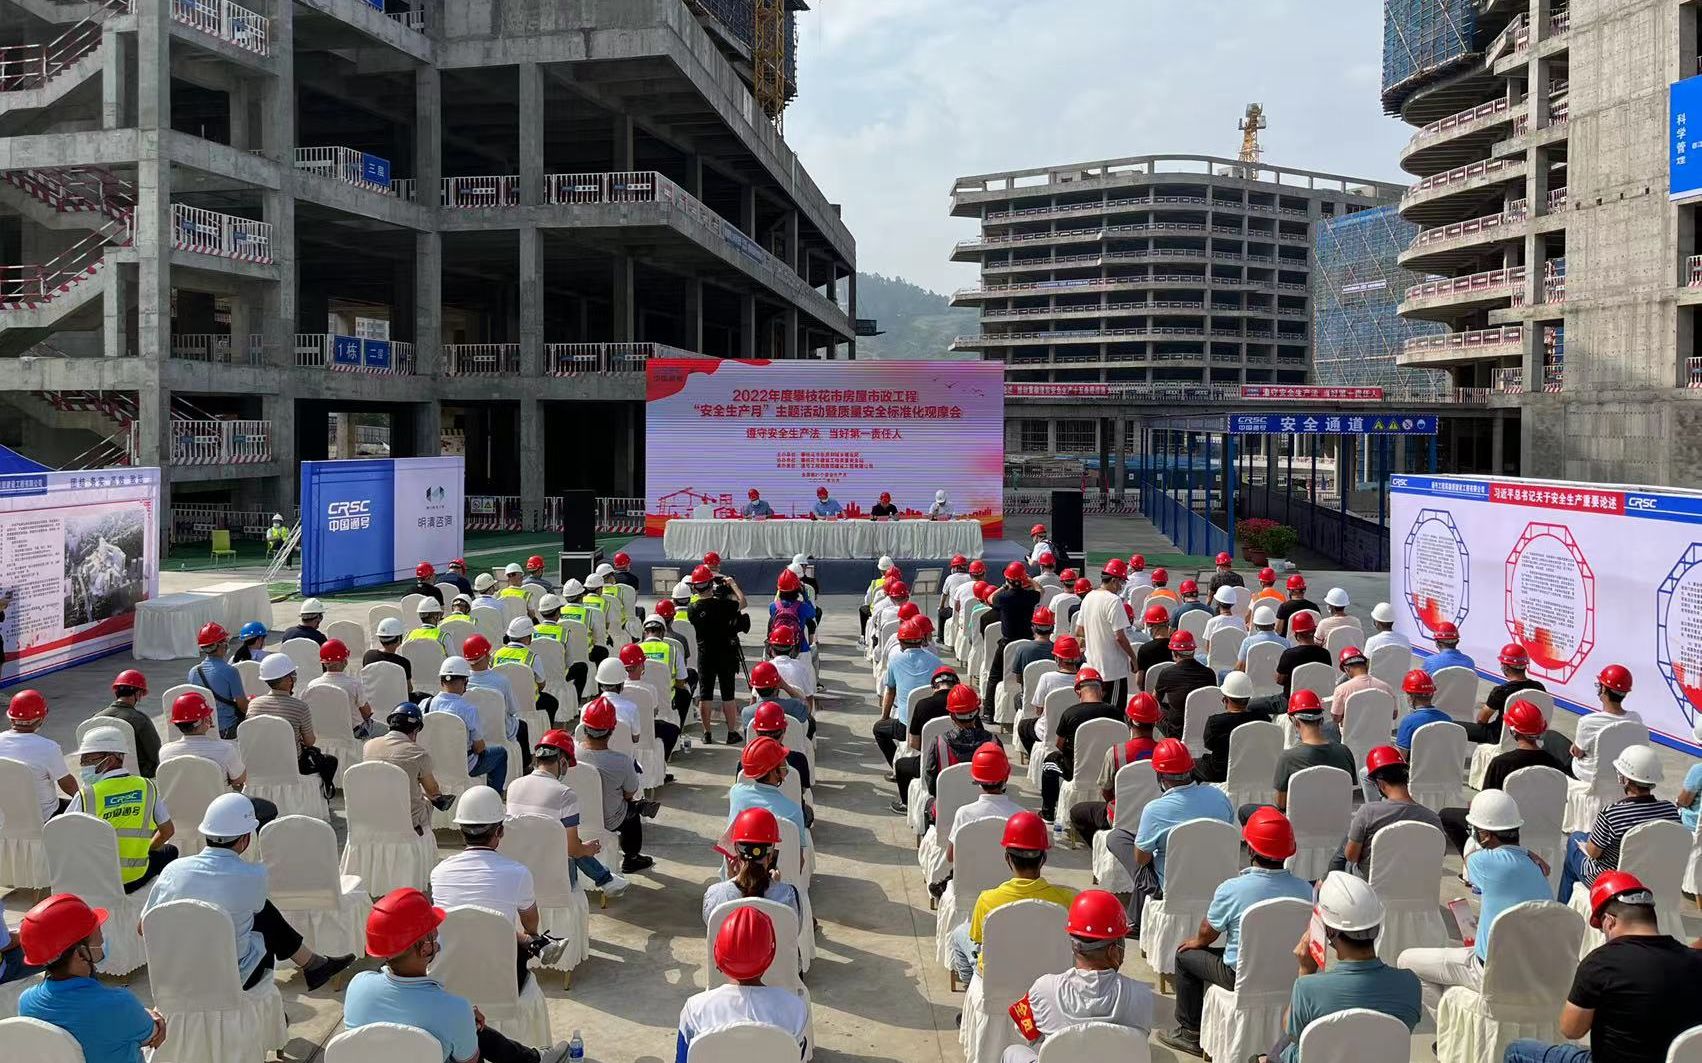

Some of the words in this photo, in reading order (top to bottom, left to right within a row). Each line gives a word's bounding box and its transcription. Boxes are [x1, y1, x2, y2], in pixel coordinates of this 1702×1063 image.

[338, 342, 358, 360] 1栋
[732, 389, 917, 403] 2022年度攀枝花市房屋市政工程
[1263, 388, 1319, 397] 遵守安全生产法
[1281, 416, 1364, 432] 安全通道
[746, 428, 820, 439] 遵守安全生产法
[829, 428, 902, 439] 当好第一责任人
[1392, 478, 1408, 486] CRSC
[1494, 487, 1617, 510] 习近平总书记关于安全生产重要论述
[1628, 497, 1658, 509] CRSC
[328, 500, 371, 517] CRSC
[329, 517, 371, 532] 中国通号
